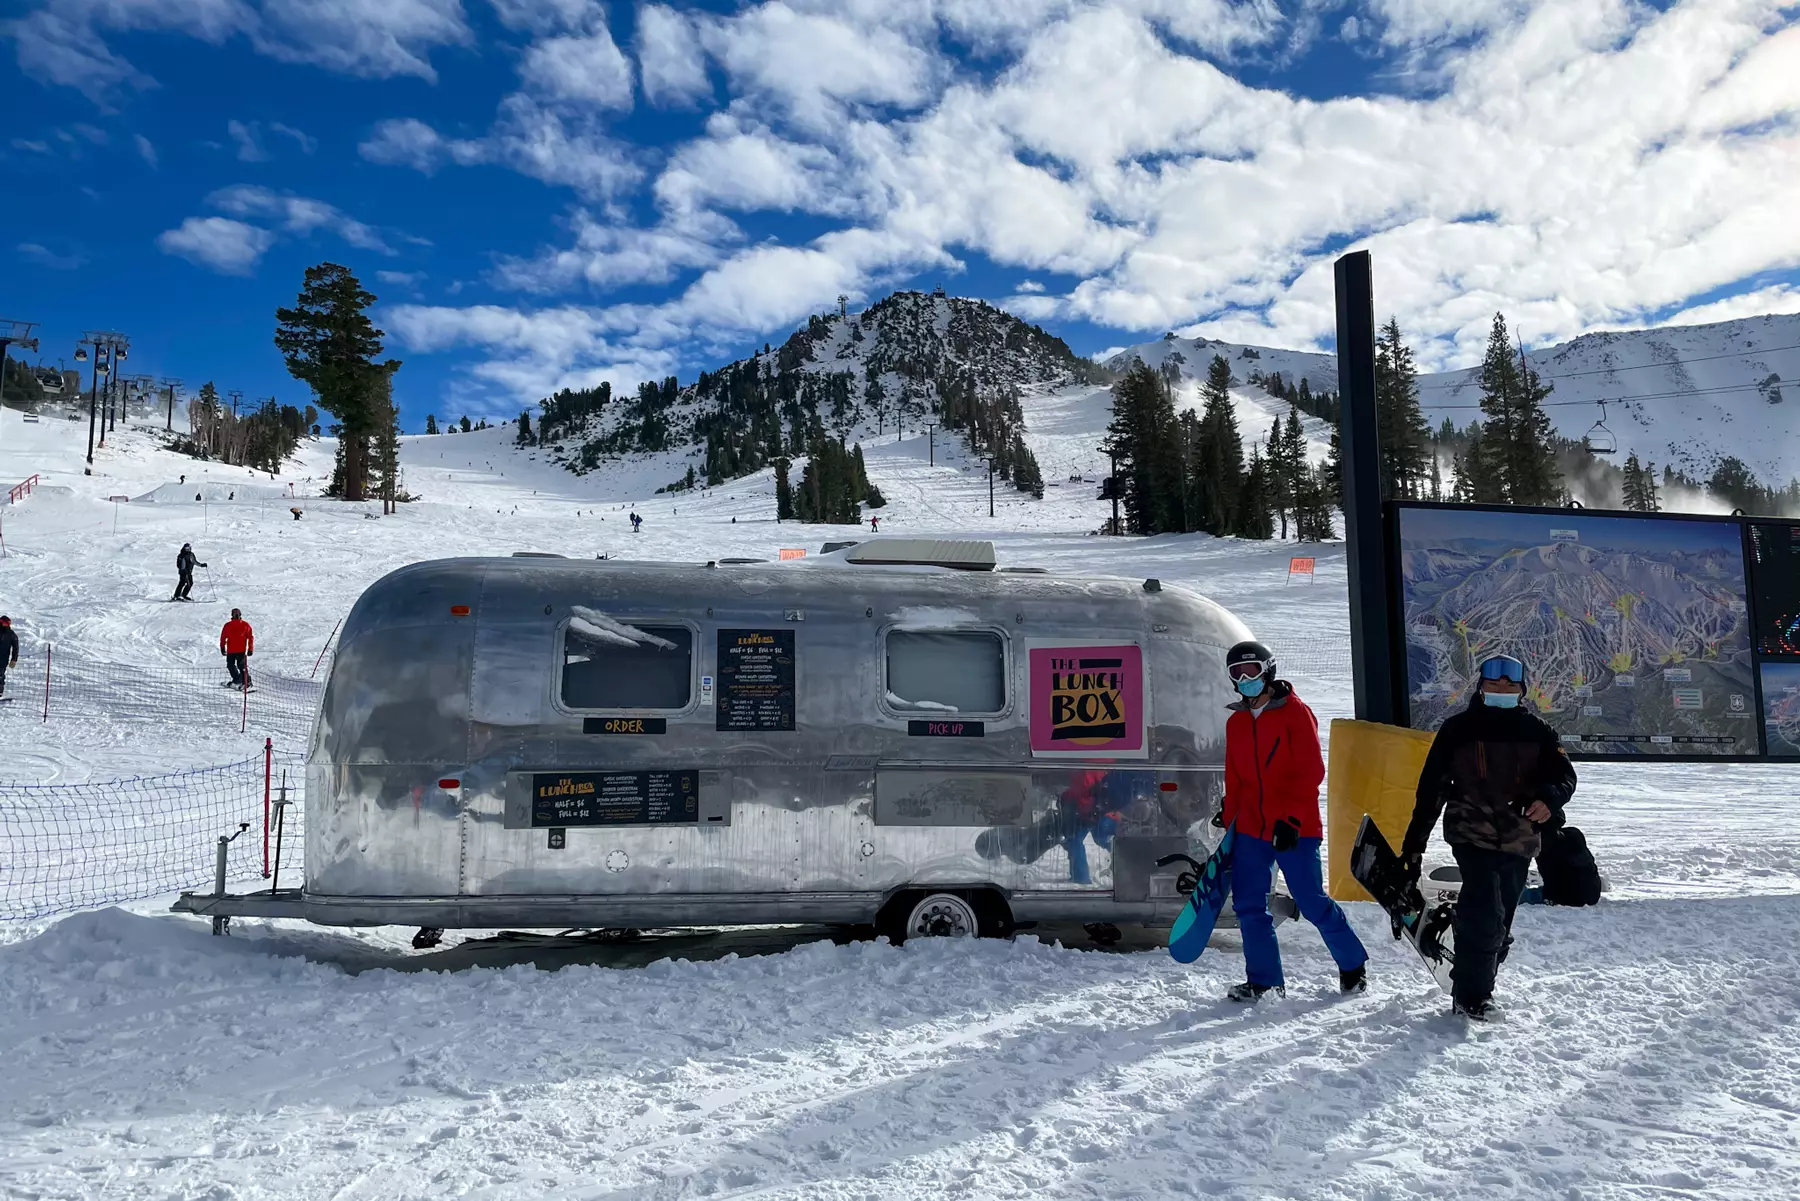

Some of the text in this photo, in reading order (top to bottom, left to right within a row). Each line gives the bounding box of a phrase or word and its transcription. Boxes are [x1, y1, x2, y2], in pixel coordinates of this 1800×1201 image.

[1051, 658, 1076, 671] THE
[1052, 672, 1124, 691] LUNCH
[1052, 690, 1121, 725] BOX
[605, 719, 644, 732] ORDER
[929, 723, 964, 735] PICK UP
[559, 810, 572, 818] FULL
[580, 810, 589, 818] $12
